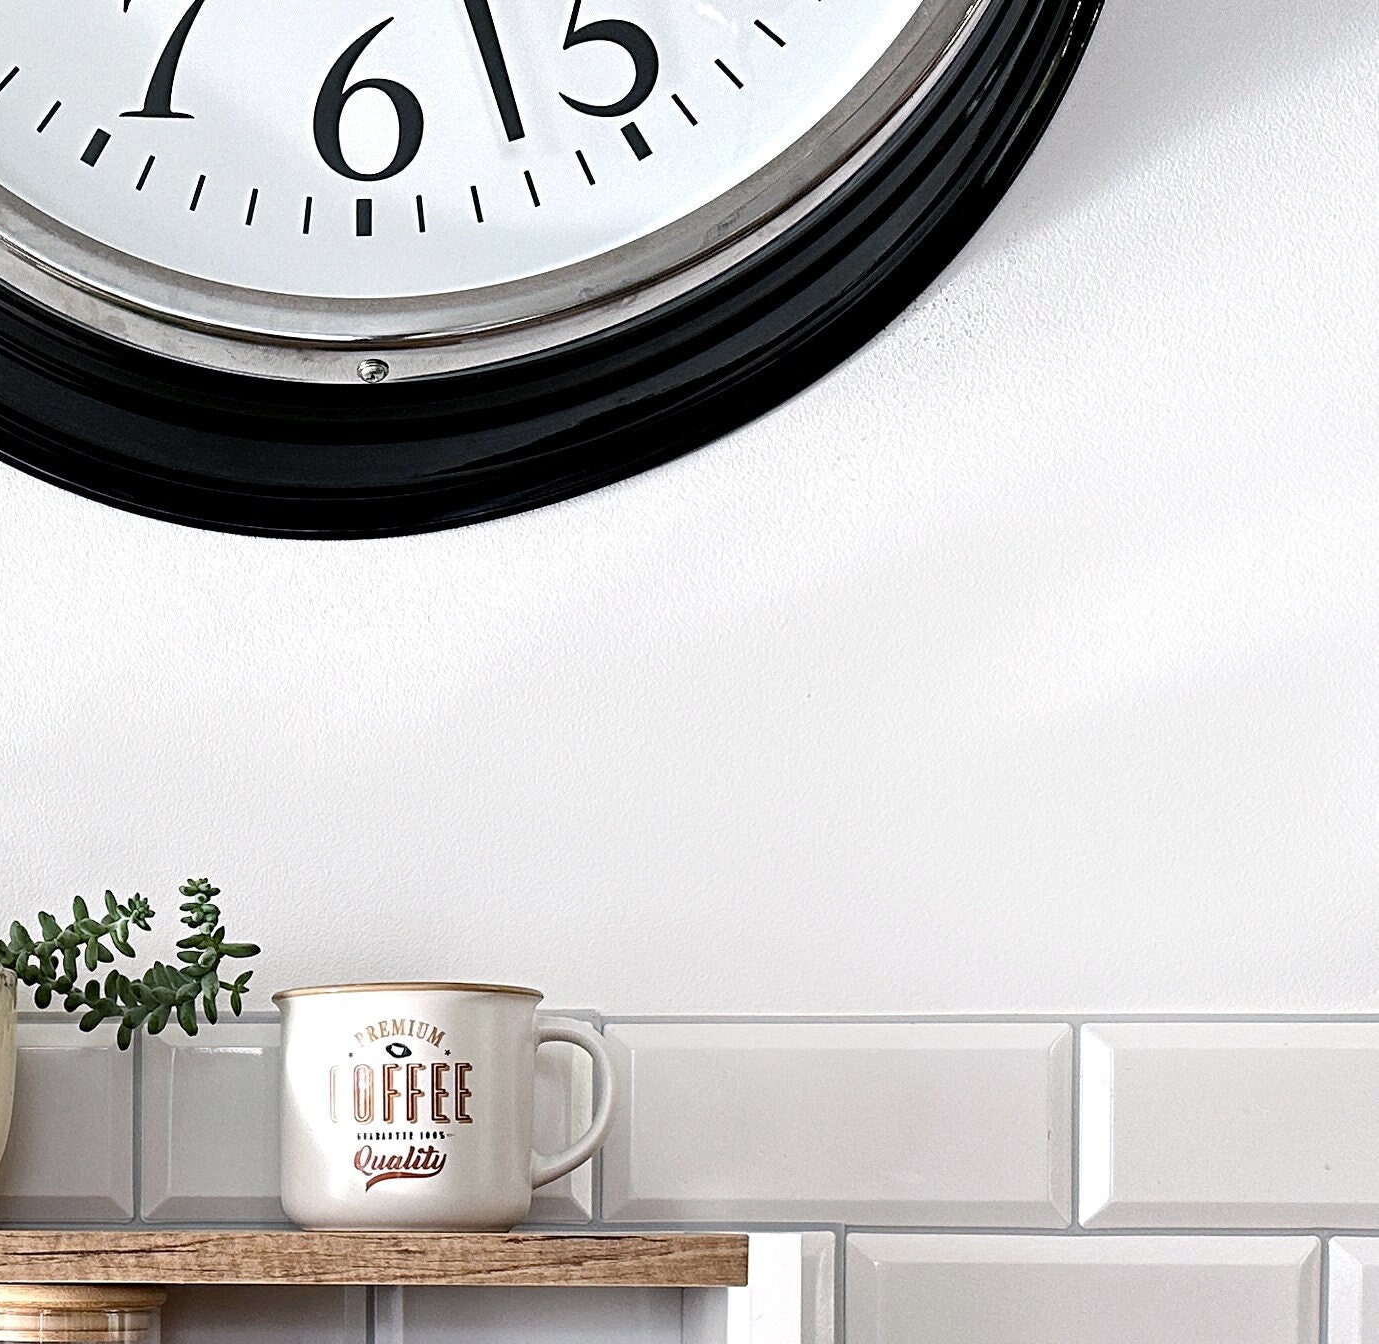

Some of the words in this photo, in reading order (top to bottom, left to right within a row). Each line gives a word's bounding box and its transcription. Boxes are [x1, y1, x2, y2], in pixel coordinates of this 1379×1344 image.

[119, 0, 206, 119] 7
[312, 16, 424, 182] 6
[558, 0, 659, 118] 5
[353, 1018, 447, 1048] PREMIUM
[353, 1144, 448, 1192] Quality
